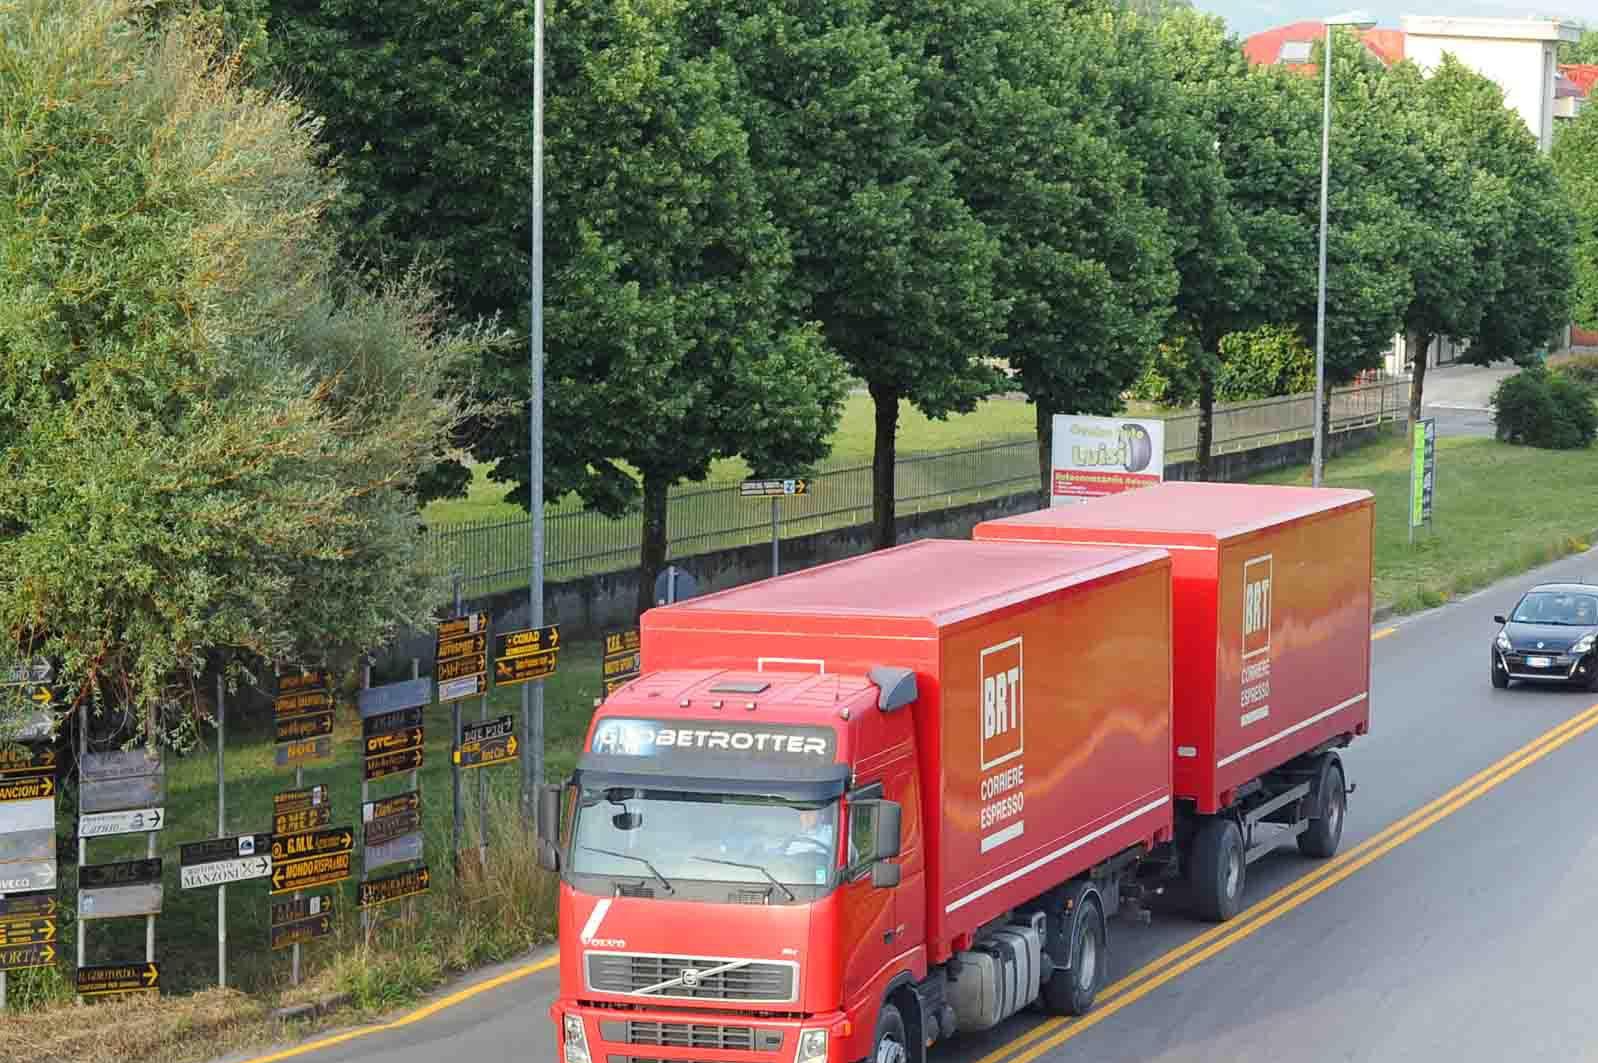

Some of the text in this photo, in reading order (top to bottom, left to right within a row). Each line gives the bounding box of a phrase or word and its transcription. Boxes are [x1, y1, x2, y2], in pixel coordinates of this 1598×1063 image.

[1245, 578, 1270, 635] BRT
[984, 665, 1020, 740] BRT
[980, 764, 1025, 801] CORRIERE
[980, 791, 1025, 830] ESPRESSO
[183, 869, 240, 888] MANZONI
